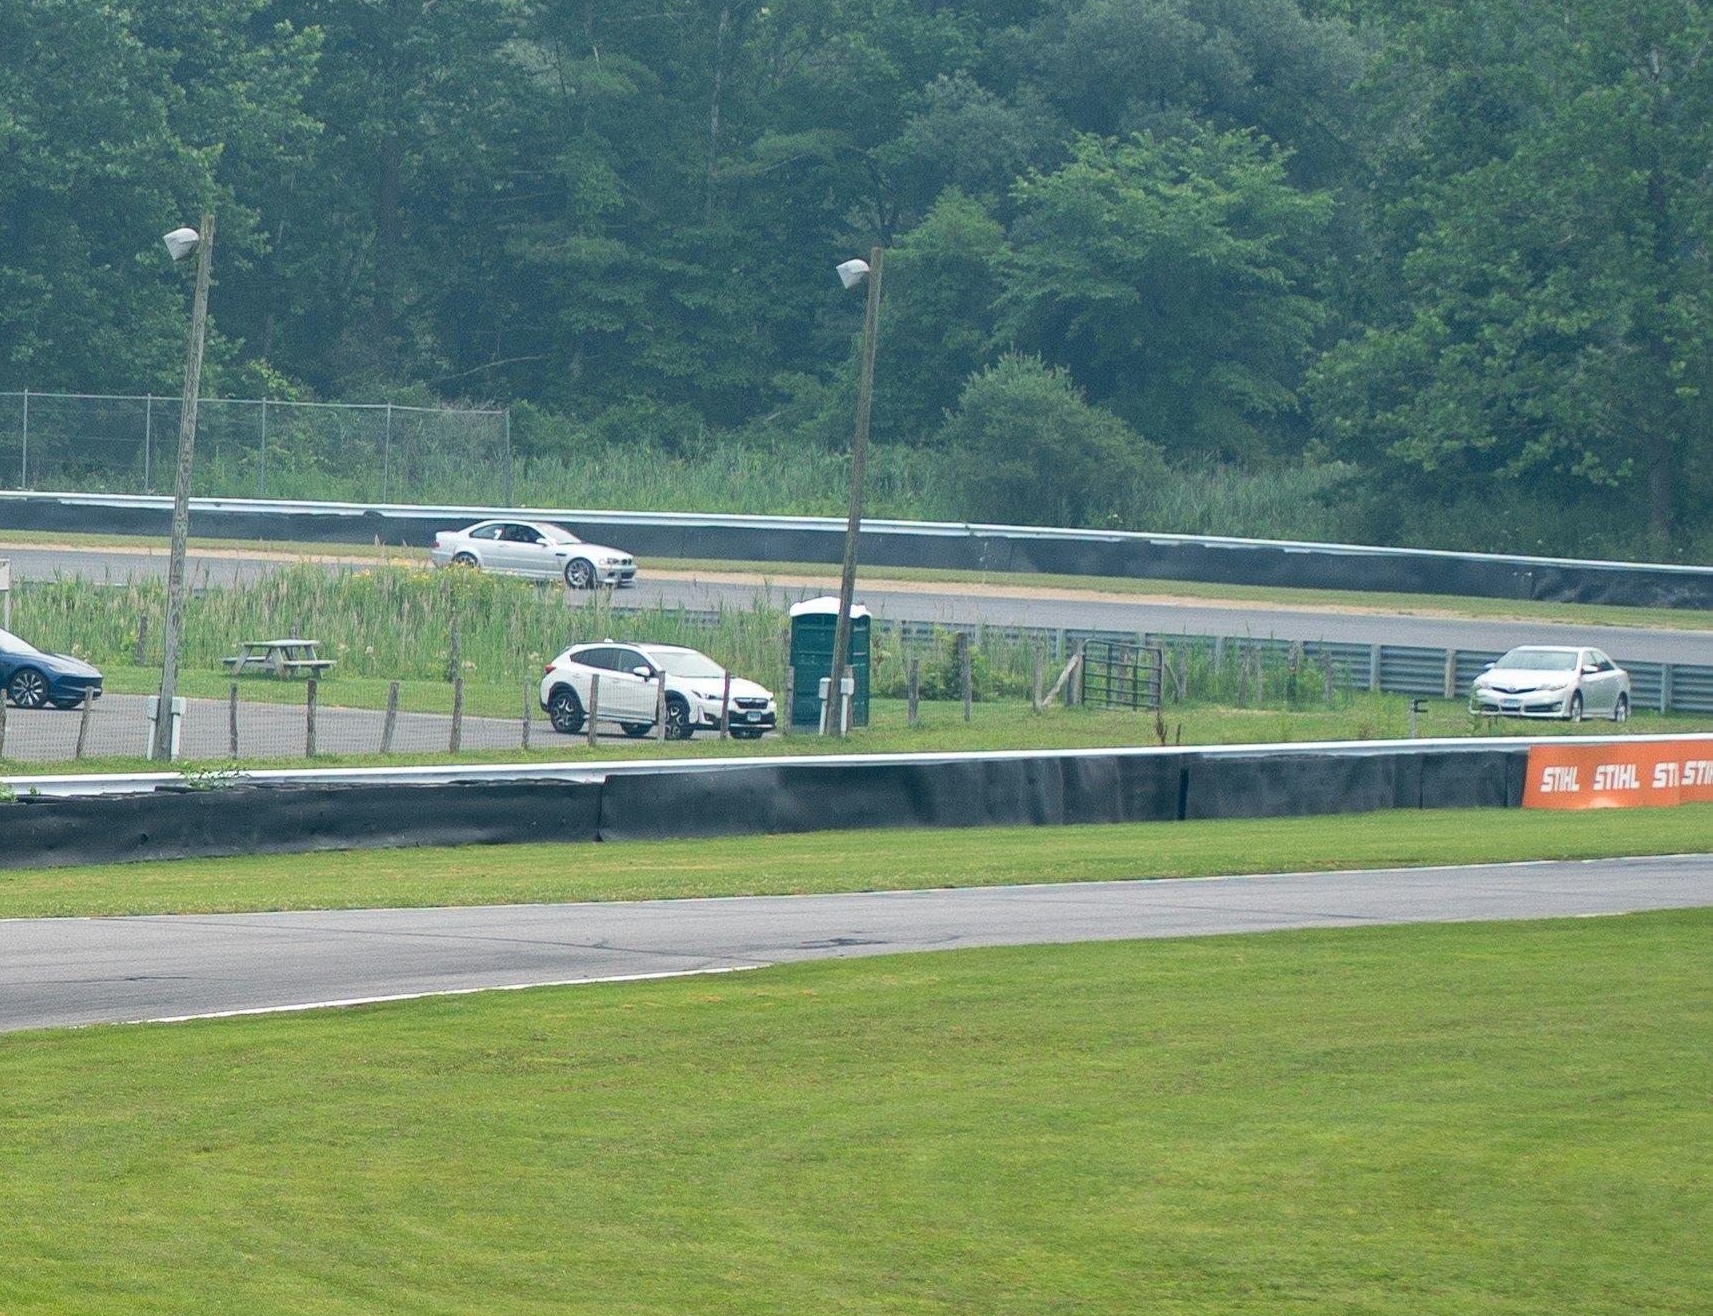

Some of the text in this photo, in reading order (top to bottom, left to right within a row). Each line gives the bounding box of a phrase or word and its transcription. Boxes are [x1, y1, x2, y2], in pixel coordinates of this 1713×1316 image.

[1539, 765, 1581, 793] STIHL
[1593, 763, 1640, 791] STIHL
[1652, 762, 1680, 788] STI
